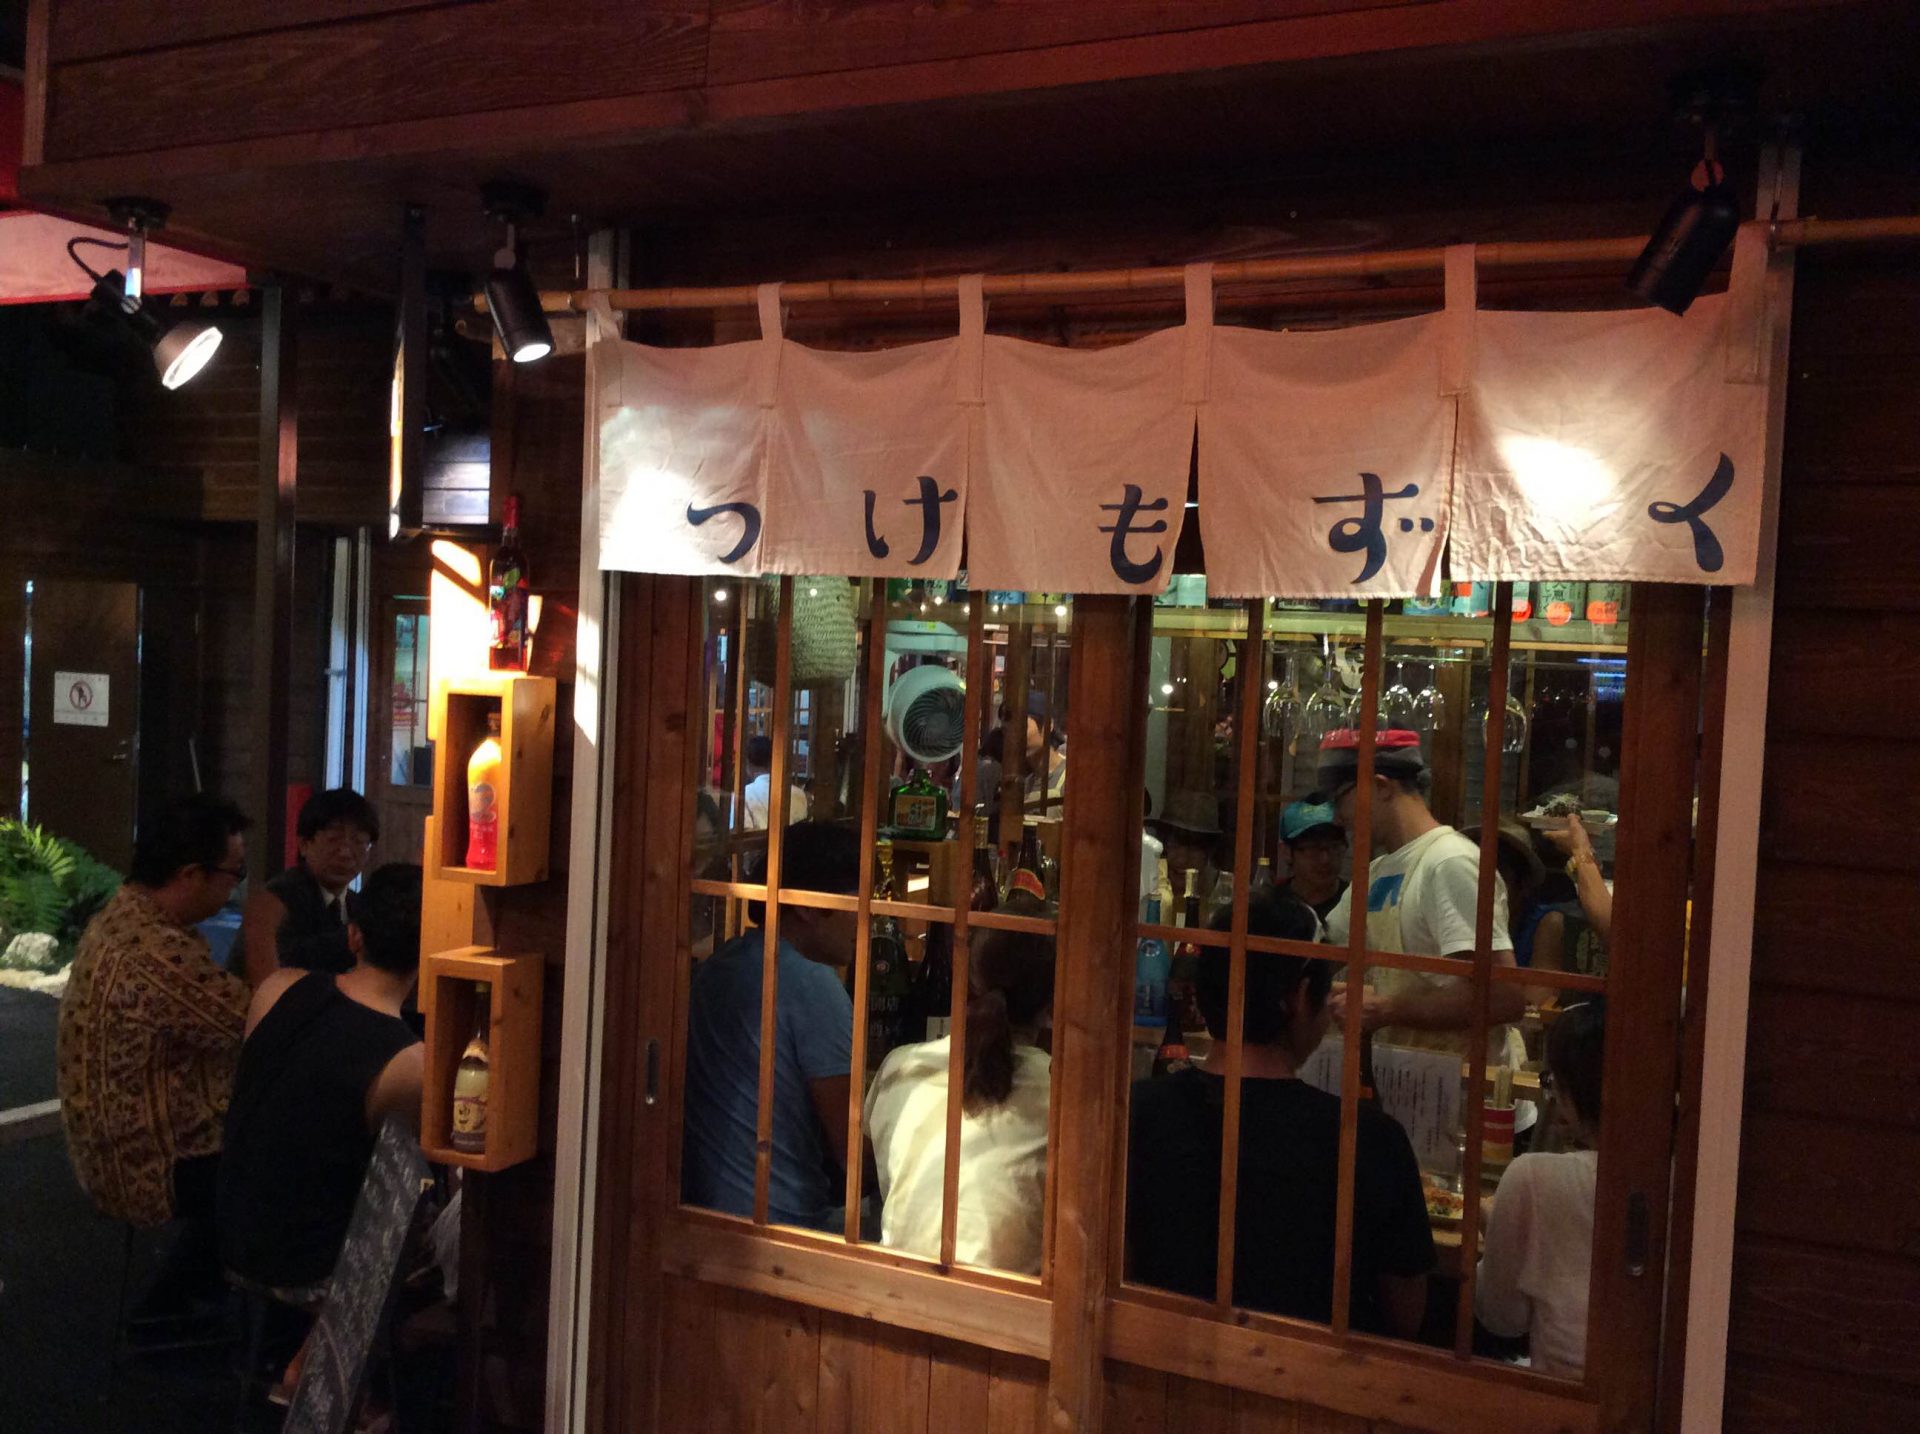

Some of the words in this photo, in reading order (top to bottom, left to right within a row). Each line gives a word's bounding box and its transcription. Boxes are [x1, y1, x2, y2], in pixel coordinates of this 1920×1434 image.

[686, 452, 1735, 585] つけもずく
